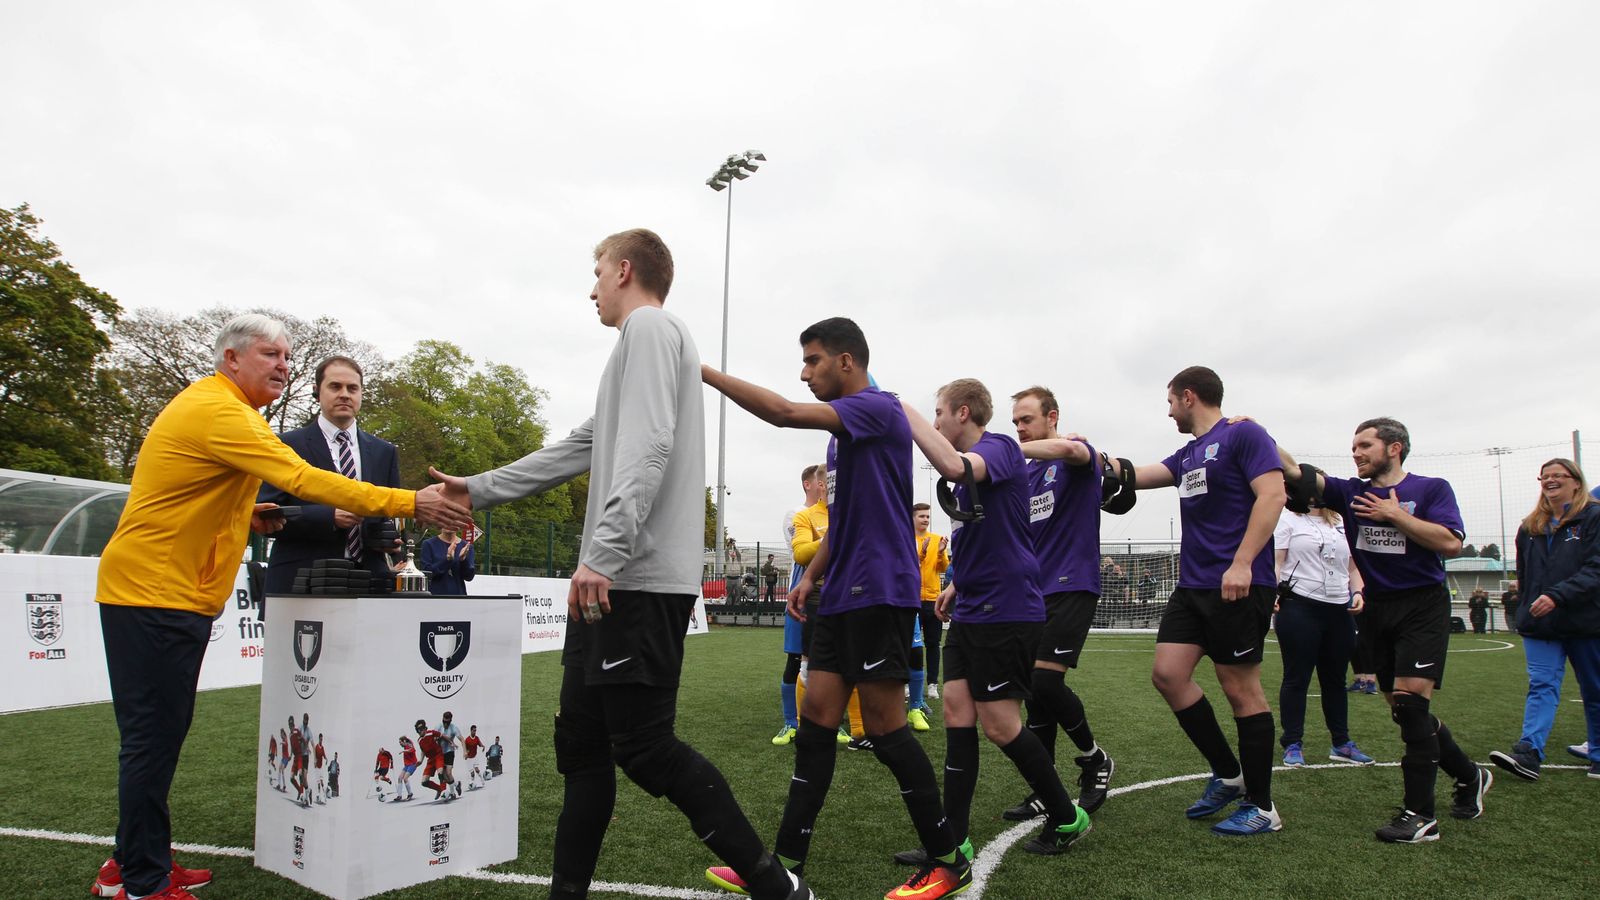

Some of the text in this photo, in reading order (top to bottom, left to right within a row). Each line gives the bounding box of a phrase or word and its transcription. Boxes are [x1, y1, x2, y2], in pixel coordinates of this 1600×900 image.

[1364, 527, 1399, 538] Slater
[1365, 537, 1405, 547] Gordon
[524, 594, 553, 609] Five cup
[526, 612, 567, 624] finals in one
[238, 617, 264, 639] fin
[47, 649, 66, 660] ALL
[240, 645, 264, 658] #Dis
[294, 674, 318, 685] DISABILITY
[424, 674, 464, 684] DISABILITY
[300, 684, 310, 693] CUP
[437, 684, 452, 693] CUP
